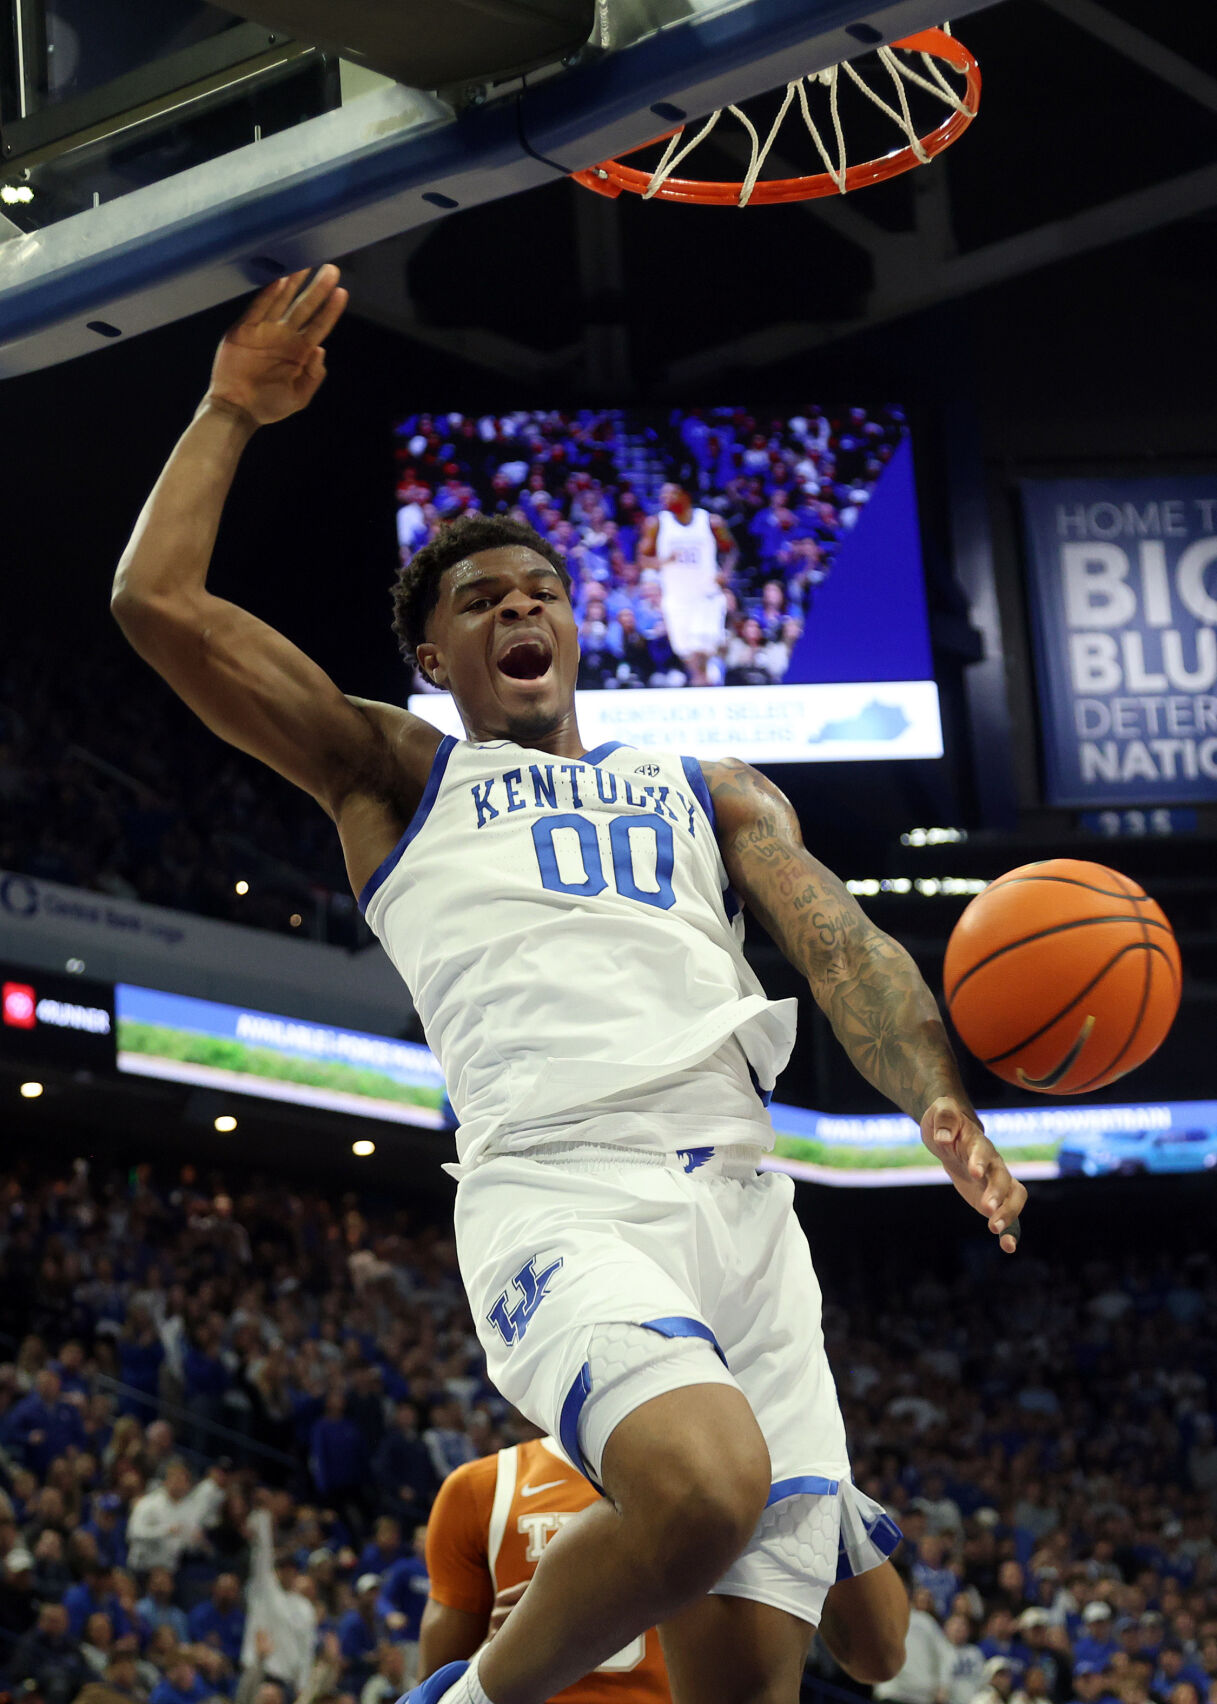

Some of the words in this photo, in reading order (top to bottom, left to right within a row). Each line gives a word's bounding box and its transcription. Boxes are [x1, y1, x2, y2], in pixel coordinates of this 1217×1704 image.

[1056, 501, 1188, 538] HOME
[1070, 627, 1217, 694] BLU
[471, 764, 696, 838] KENTUCKY
[531, 813, 677, 911] 00
[793, 884, 818, 911] not
